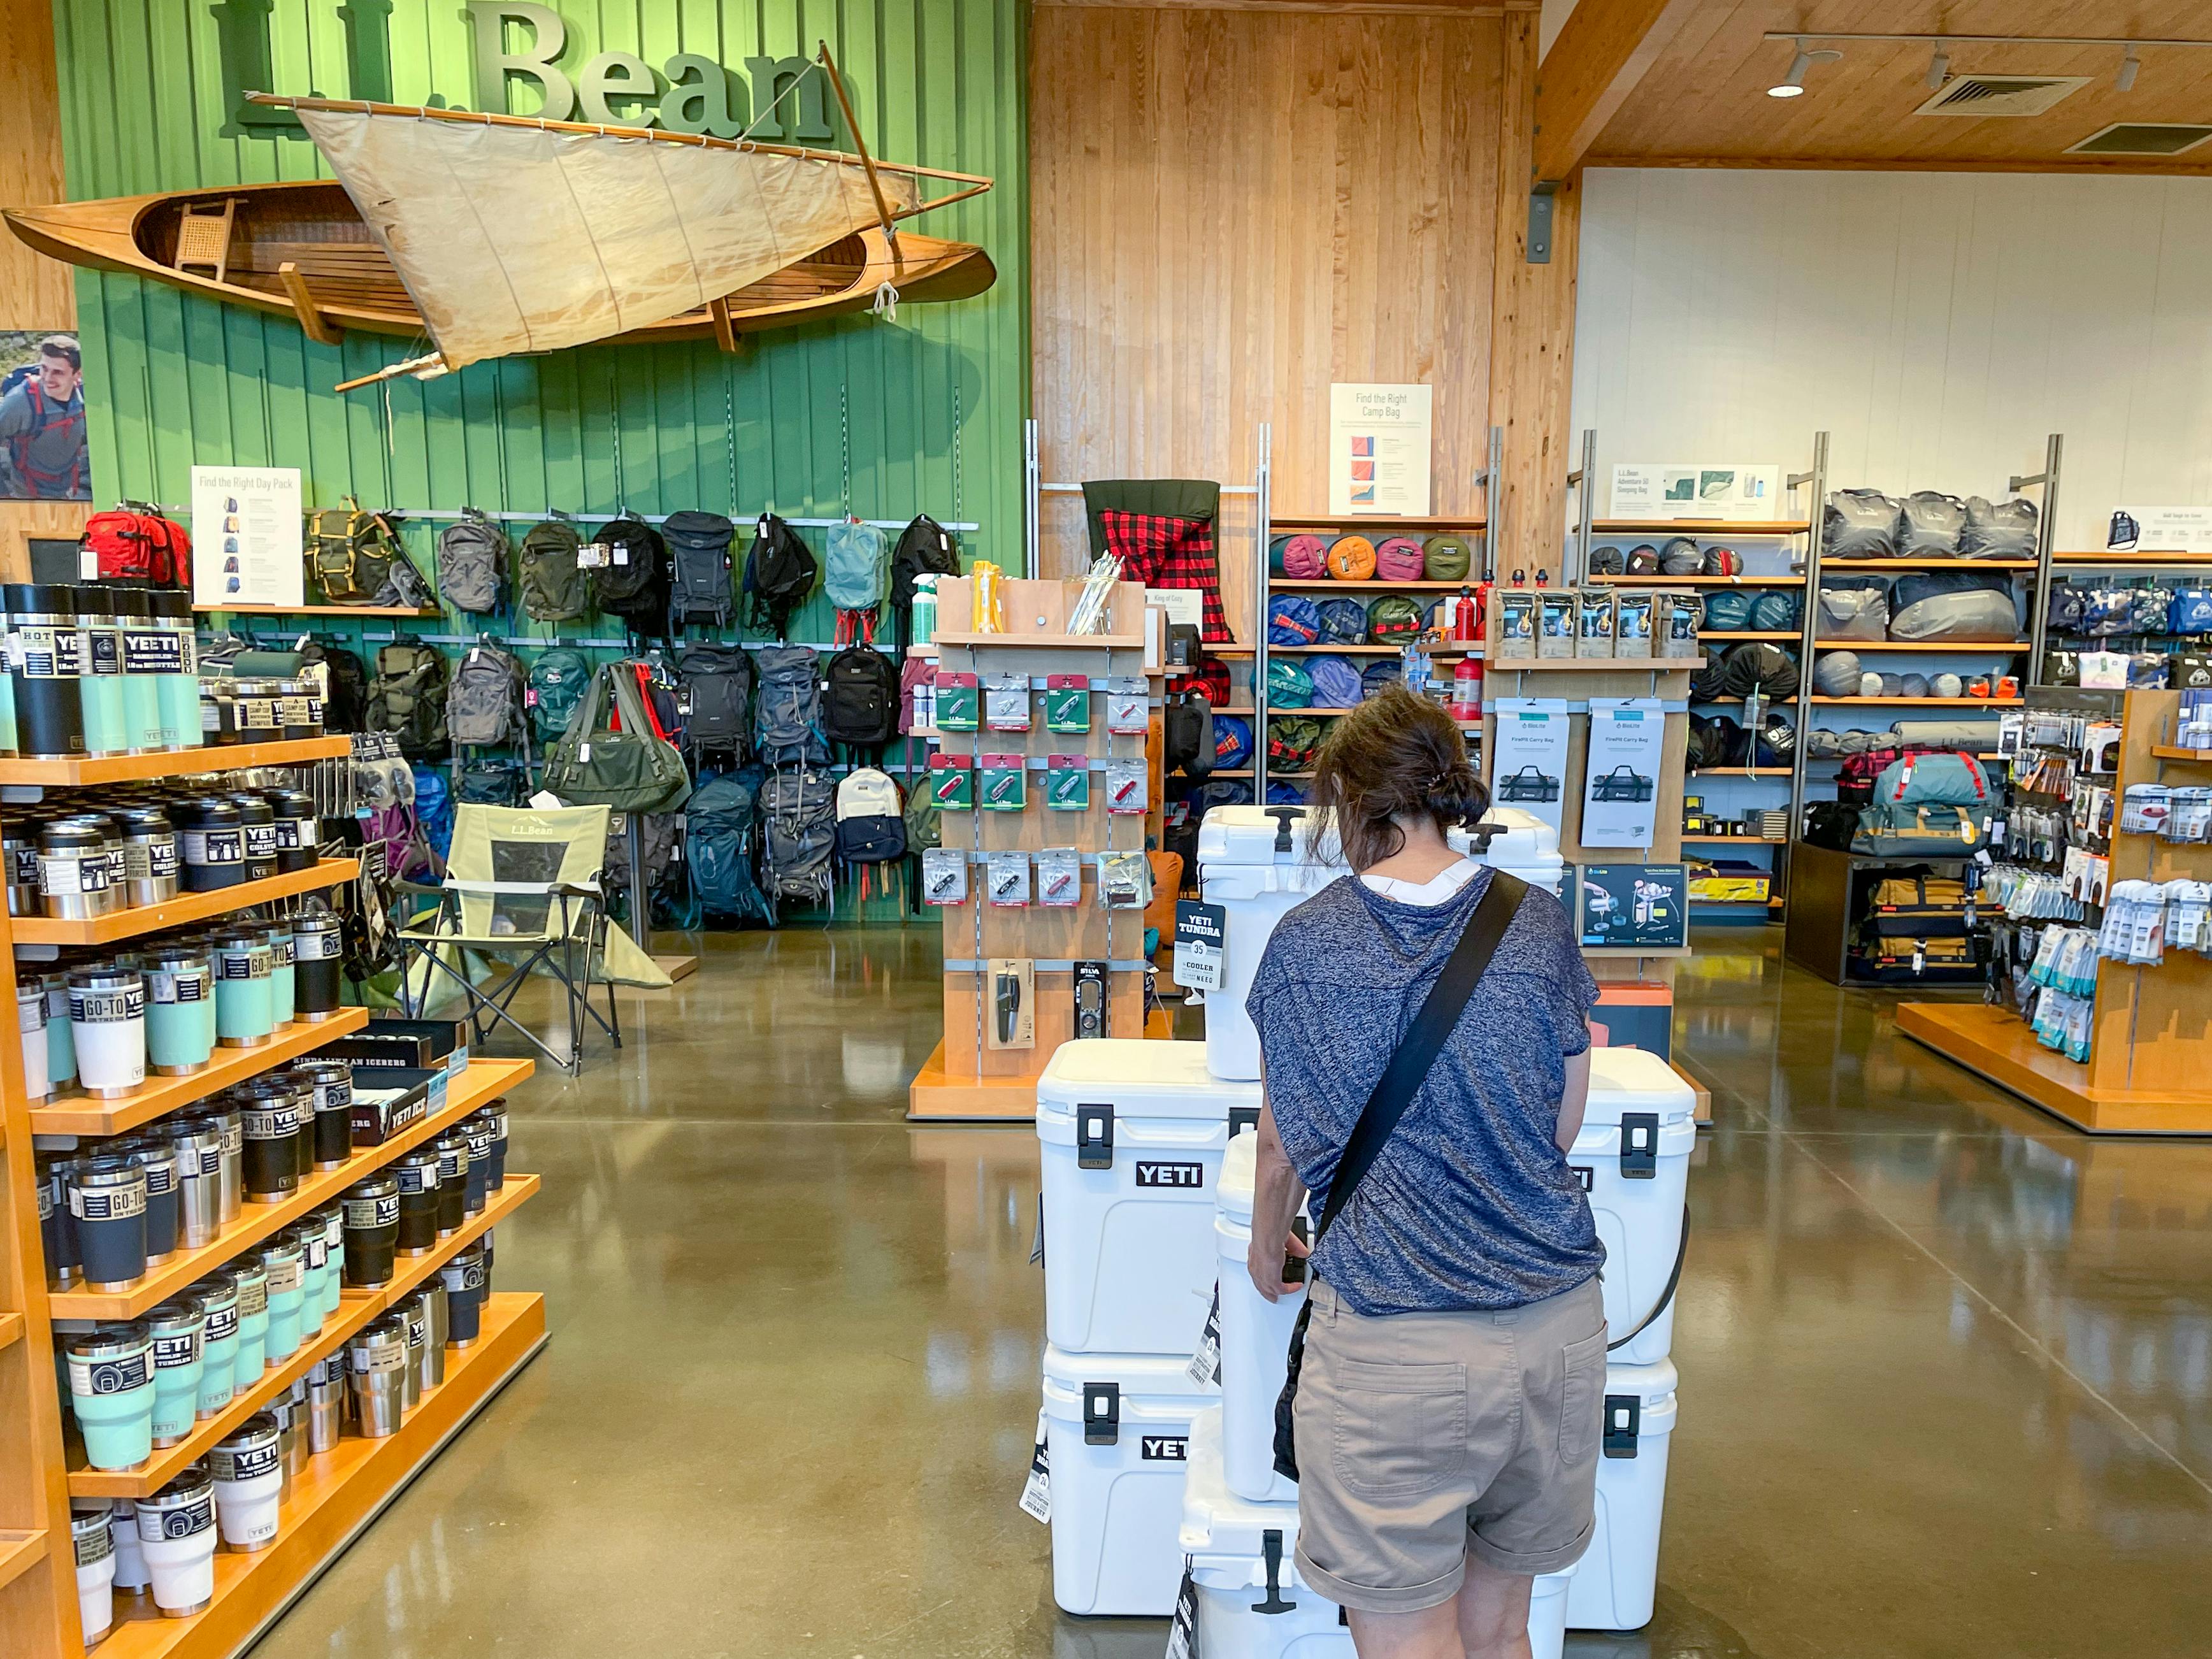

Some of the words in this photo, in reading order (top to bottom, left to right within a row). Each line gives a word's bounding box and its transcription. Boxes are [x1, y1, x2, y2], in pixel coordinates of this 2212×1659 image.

[226, 0, 832, 138] LLBean
[1356, 393, 1372, 403] Find
[1374, 394, 1386, 403] the
[1388, 394, 1407, 406] Right
[1363, 406, 1382, 418] Camp
[1386, 407, 1400, 419] Bag
[199, 477, 217, 487] Find
[219, 477, 231, 487] the
[233, 477, 254, 491] Right
[256, 478, 271, 492] Day
[273, 478, 293, 489] Pack
[56, 636, 77, 650] YE
[273, 702, 283, 712] YE
[310, 700, 321, 710] YE
[1942, 738, 1983, 746] LLBean
[512, 825, 553, 834] L.L.Bean
[18, 851, 37, 864] YE
[107, 851, 125, 864] YE
[150, 845, 175, 859] YET
[1188, 915, 1212, 926] YETI
[1179, 923, 1221, 937] TUNDRA
[1194, 945, 1203, 954] 35
[252, 958, 270, 972] GO-T
[1186, 962, 1214, 972] COOLER
[126, 991, 143, 1005] YE
[86, 998, 124, 1016] GO-TO
[299, 1101, 312, 1115] -TO
[392, 1107, 413, 1129] YETI
[412, 1096, 427, 1117] ICE
[275, 1110, 298, 1124] YET
[243, 1118, 272, 1132] GO-TO
[468, 1134, 489, 1148] YET
[1138, 1165, 1198, 1184] YETI
[379, 1196, 399, 1212] YET
[205, 1307, 236, 1327] ETI
[412, 1319, 424, 1334] YE
[156, 1337, 191, 1354] ETI
[207, 1392, 229, 1402] YETI
[238, 1444, 278, 1466] YETI
[1144, 1440, 1188, 1458] YET
[1040, 1476, 1047, 1487] 24
[251, 1524, 273, 1536] YETI
